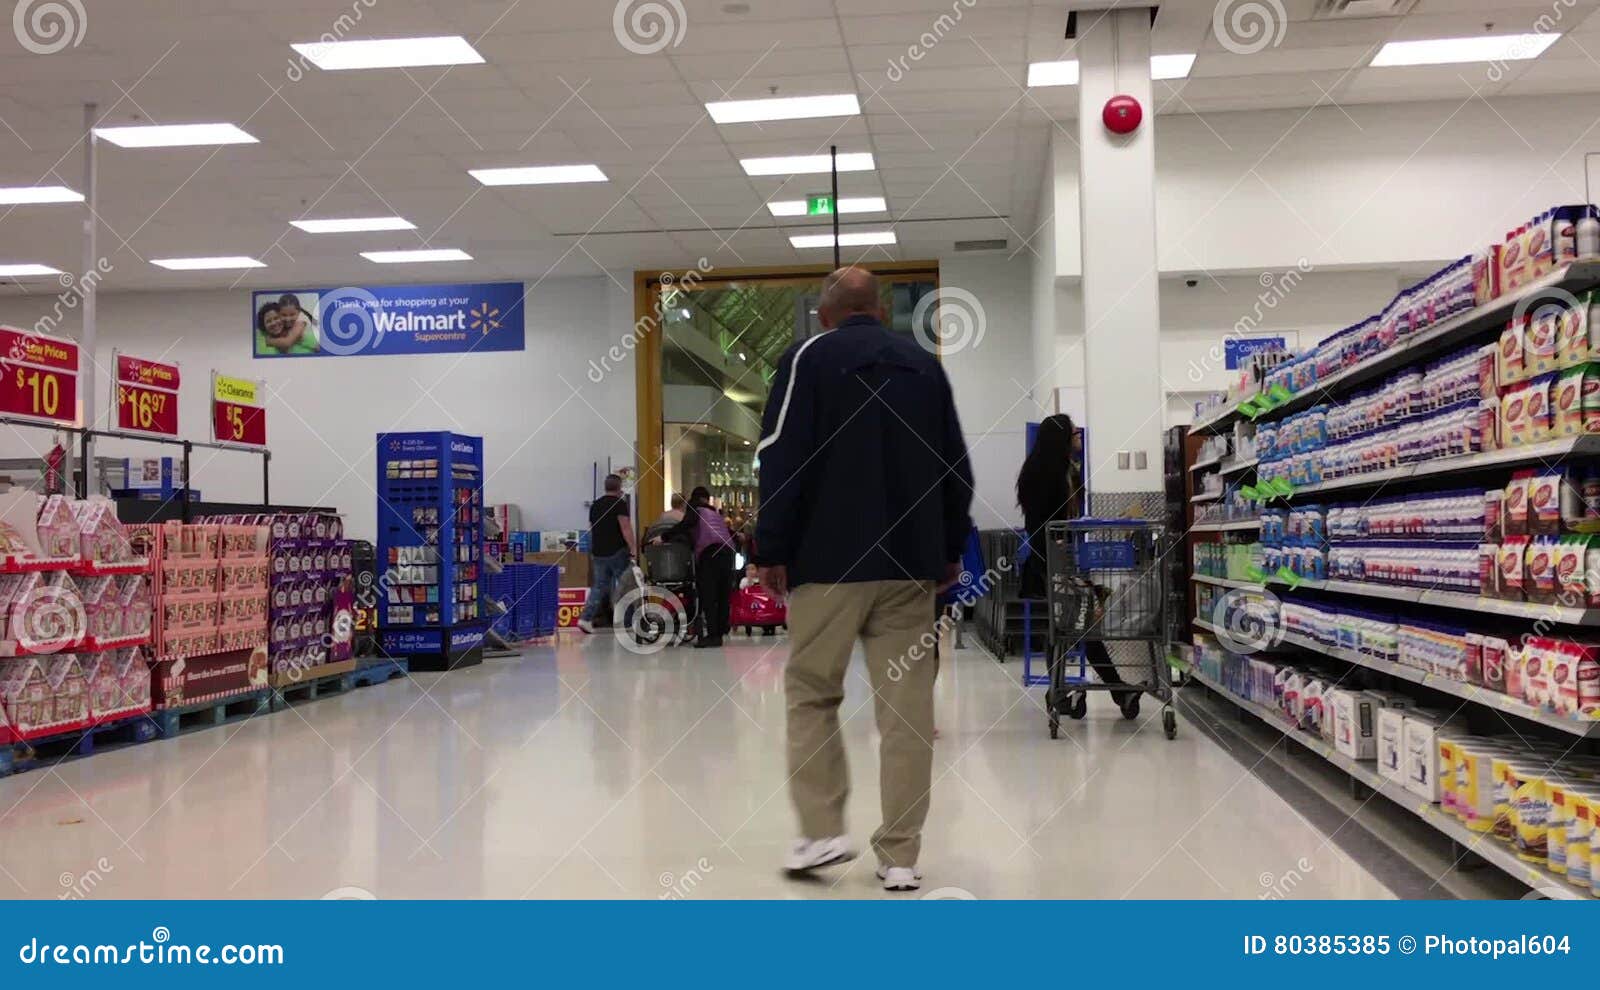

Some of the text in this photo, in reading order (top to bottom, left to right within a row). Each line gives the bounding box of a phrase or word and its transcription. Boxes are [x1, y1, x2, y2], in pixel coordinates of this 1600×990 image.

[334, 300, 360, 309] Thank
[381, 298, 392, 307] for
[395, 298, 436, 308] shopping
[438, 297, 447, 305] at
[448, 297, 470, 307] your
[372, 309, 467, 333] Walmart
[415, 332, 467, 343] Supercentre
[44, 343, 68, 361] Prices
[227, 383, 254, 400] Clearance
